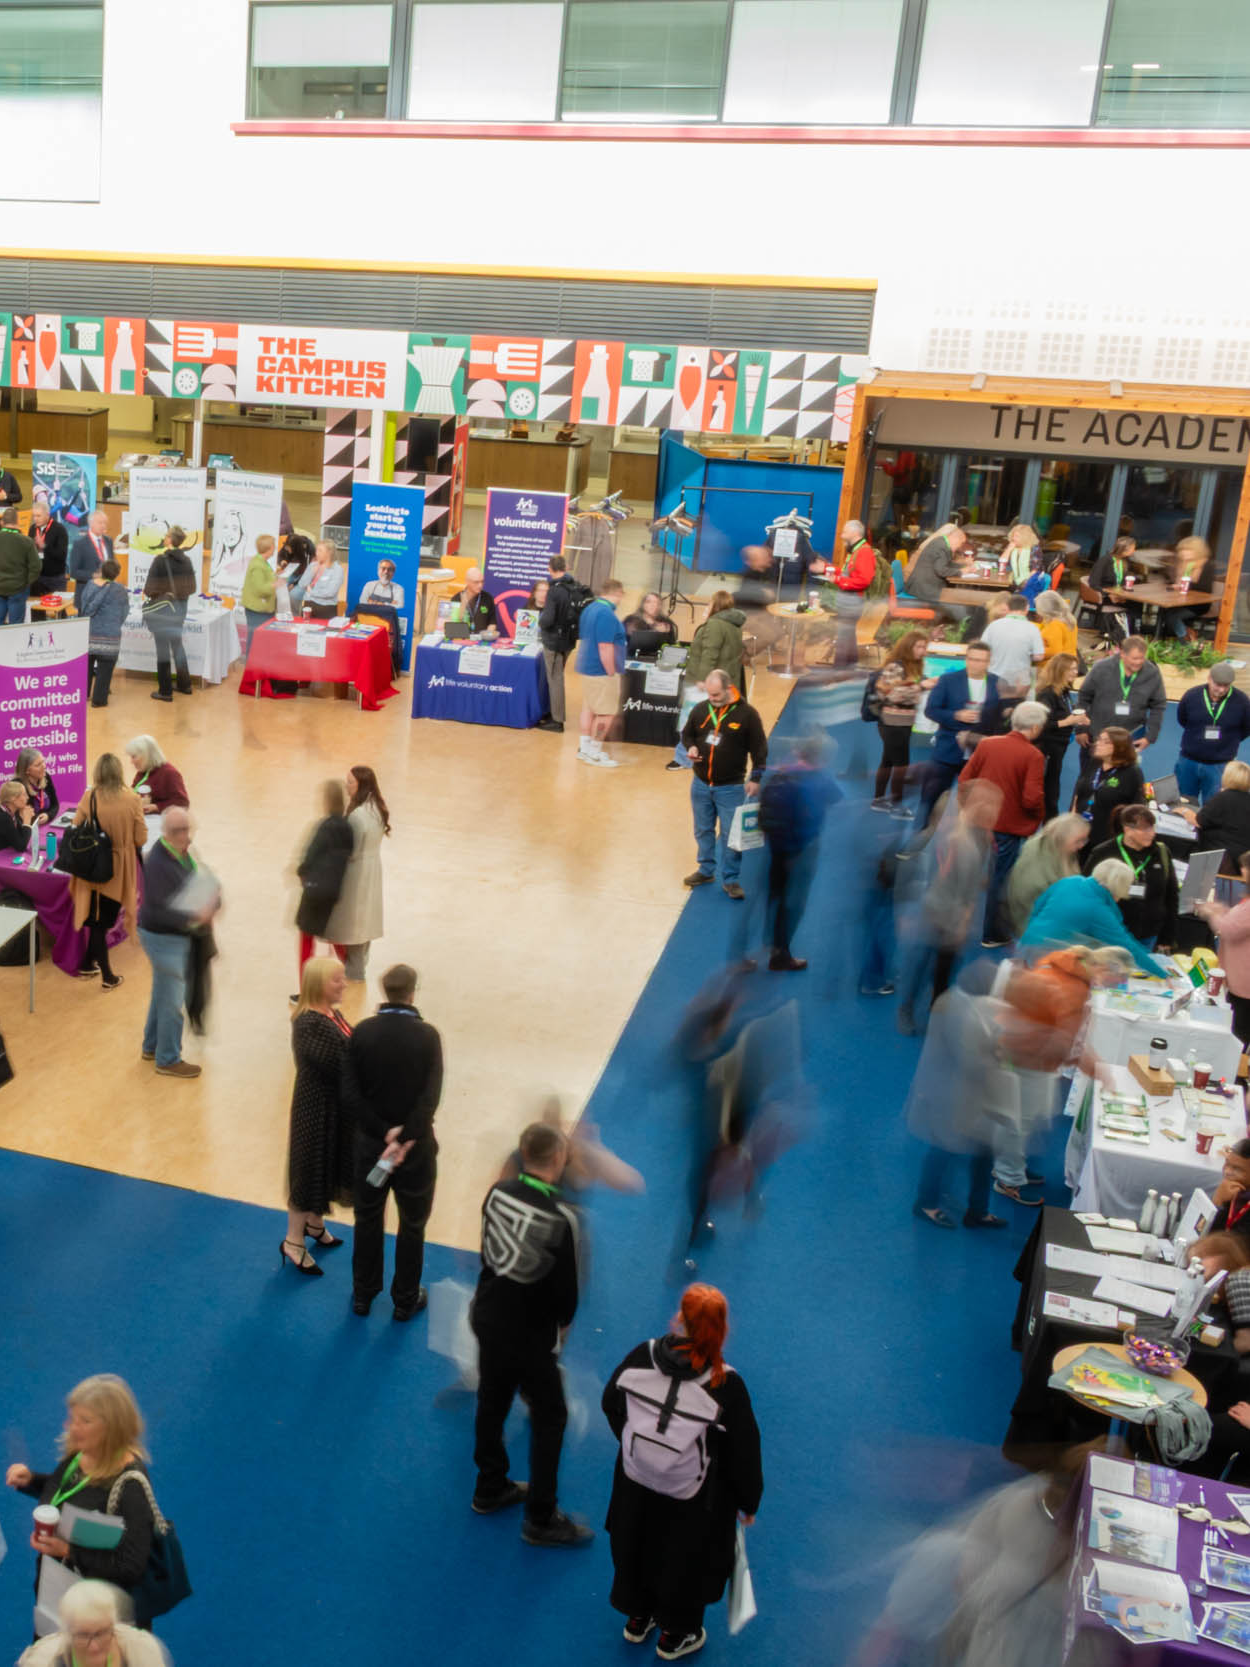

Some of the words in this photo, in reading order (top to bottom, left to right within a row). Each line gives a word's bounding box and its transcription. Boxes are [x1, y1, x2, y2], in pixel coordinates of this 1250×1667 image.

[257, 336, 317, 357] THE
[256, 355, 387, 380] CAMPUS
[255, 374, 386, 400] KITCHEN
[989, 404, 1071, 443] THE
[36, 461, 56, 476] SiS
[365, 503, 400, 516] Looking
[400, 507, 410, 516] to
[366, 521, 387, 530] your
[387, 524, 406, 533] own
[369, 513, 392, 523] start
[392, 516, 404, 525] up
[493, 516, 558, 533] volunteering
[364, 528, 407, 541] business?
[13, 674, 40, 691] We
[43, 674, 68, 688] are
[456, 680, 490, 692] voluntary
[489, 684, 514, 694] action
[0, 688, 81, 713] committed
[10, 716, 27, 731] to
[30, 711, 72, 728] being
[3, 729, 79, 751] accessible
[3, 759, 14, 769] to
[57, 752, 79, 763] who
[57, 766, 67, 775] in
[67, 763, 84, 775] Fife
